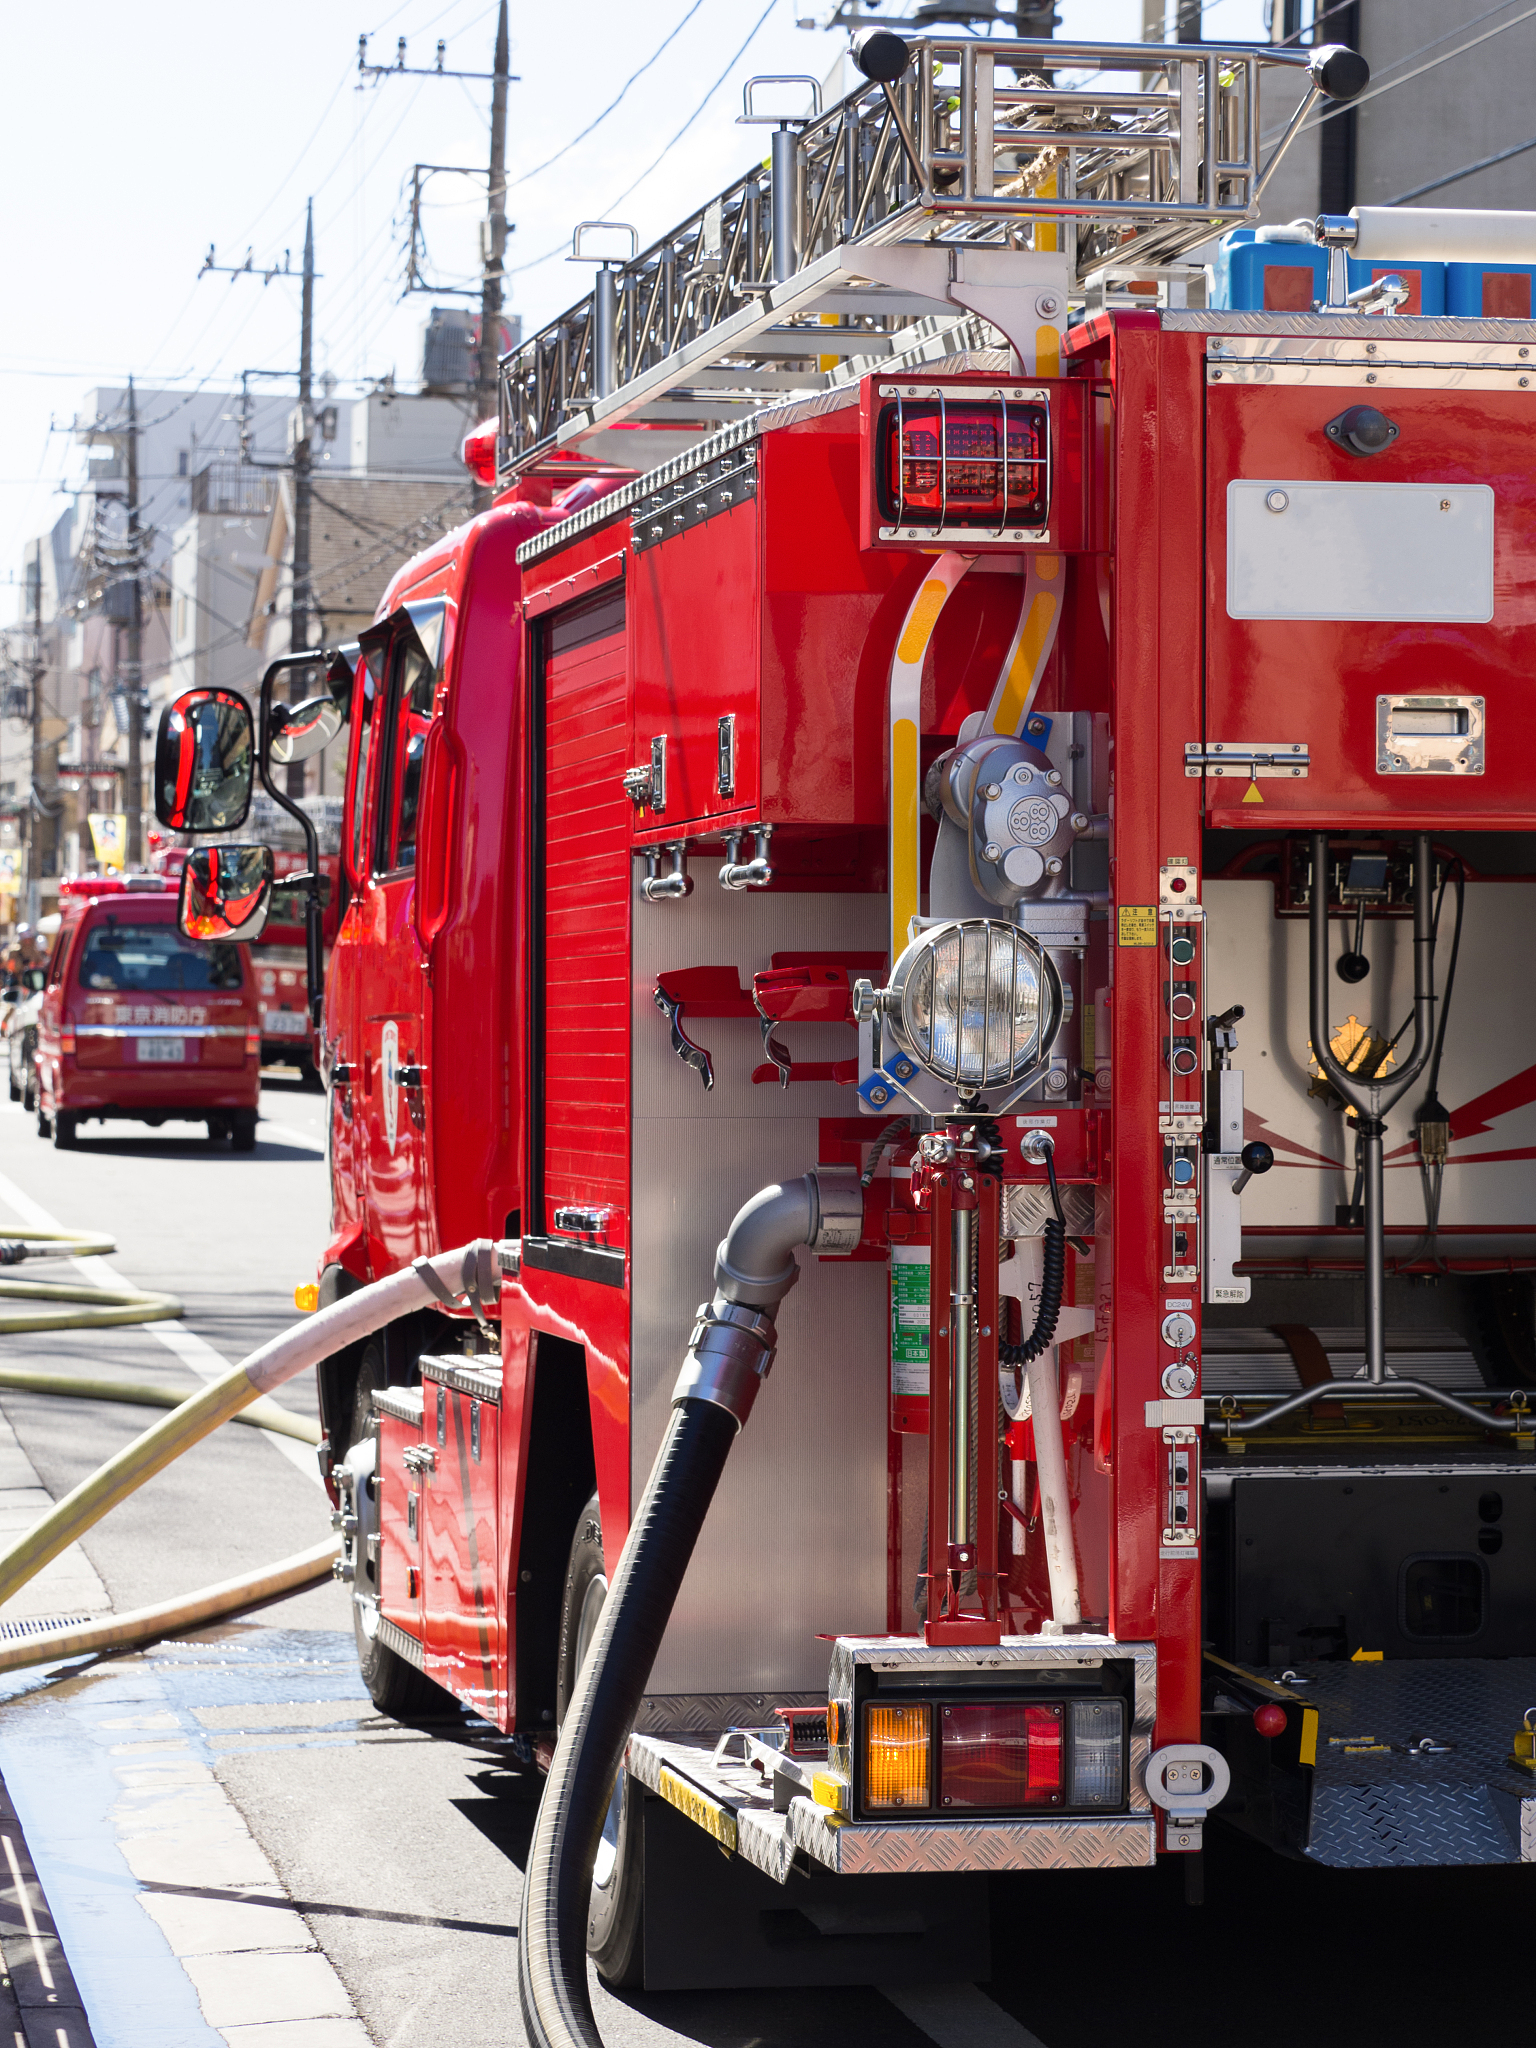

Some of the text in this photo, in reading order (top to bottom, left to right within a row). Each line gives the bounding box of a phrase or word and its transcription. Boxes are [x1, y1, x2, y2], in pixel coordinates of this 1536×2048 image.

[115, 1005, 207, 1025] 東京消防庁
[1213, 1156, 1242, 1165] 通常位置
[1215, 1289, 1243, 1298] 緊急解除
